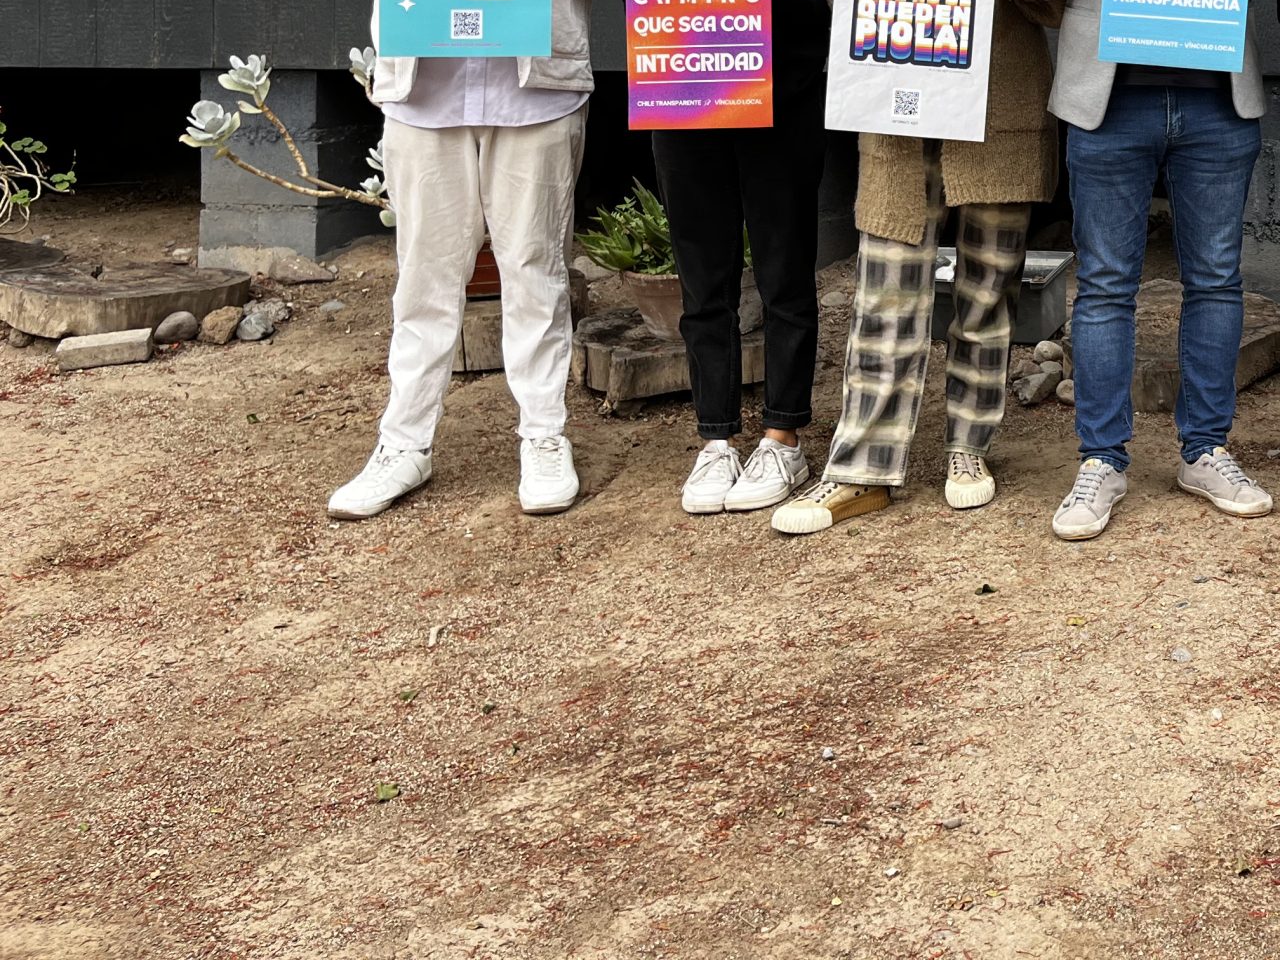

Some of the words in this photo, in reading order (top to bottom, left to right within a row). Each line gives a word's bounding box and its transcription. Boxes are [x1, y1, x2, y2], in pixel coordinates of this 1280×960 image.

[633, 16, 675, 37] QUE
[678, 15, 717, 33] SEA
[720, 15, 762, 32] CON
[854, 17, 970, 65] PIOLA!
[1108, 36, 1128, 44] CHILE
[1128, 38, 1179, 48] TRANSPARENTE
[1184, 42, 1214, 51] VÍNCULO
[1214, 45, 1237, 53] LOCAL
[636, 52, 764, 74] INTEGRIDAD
[656, 99, 701, 107] TRANSPARENTE
